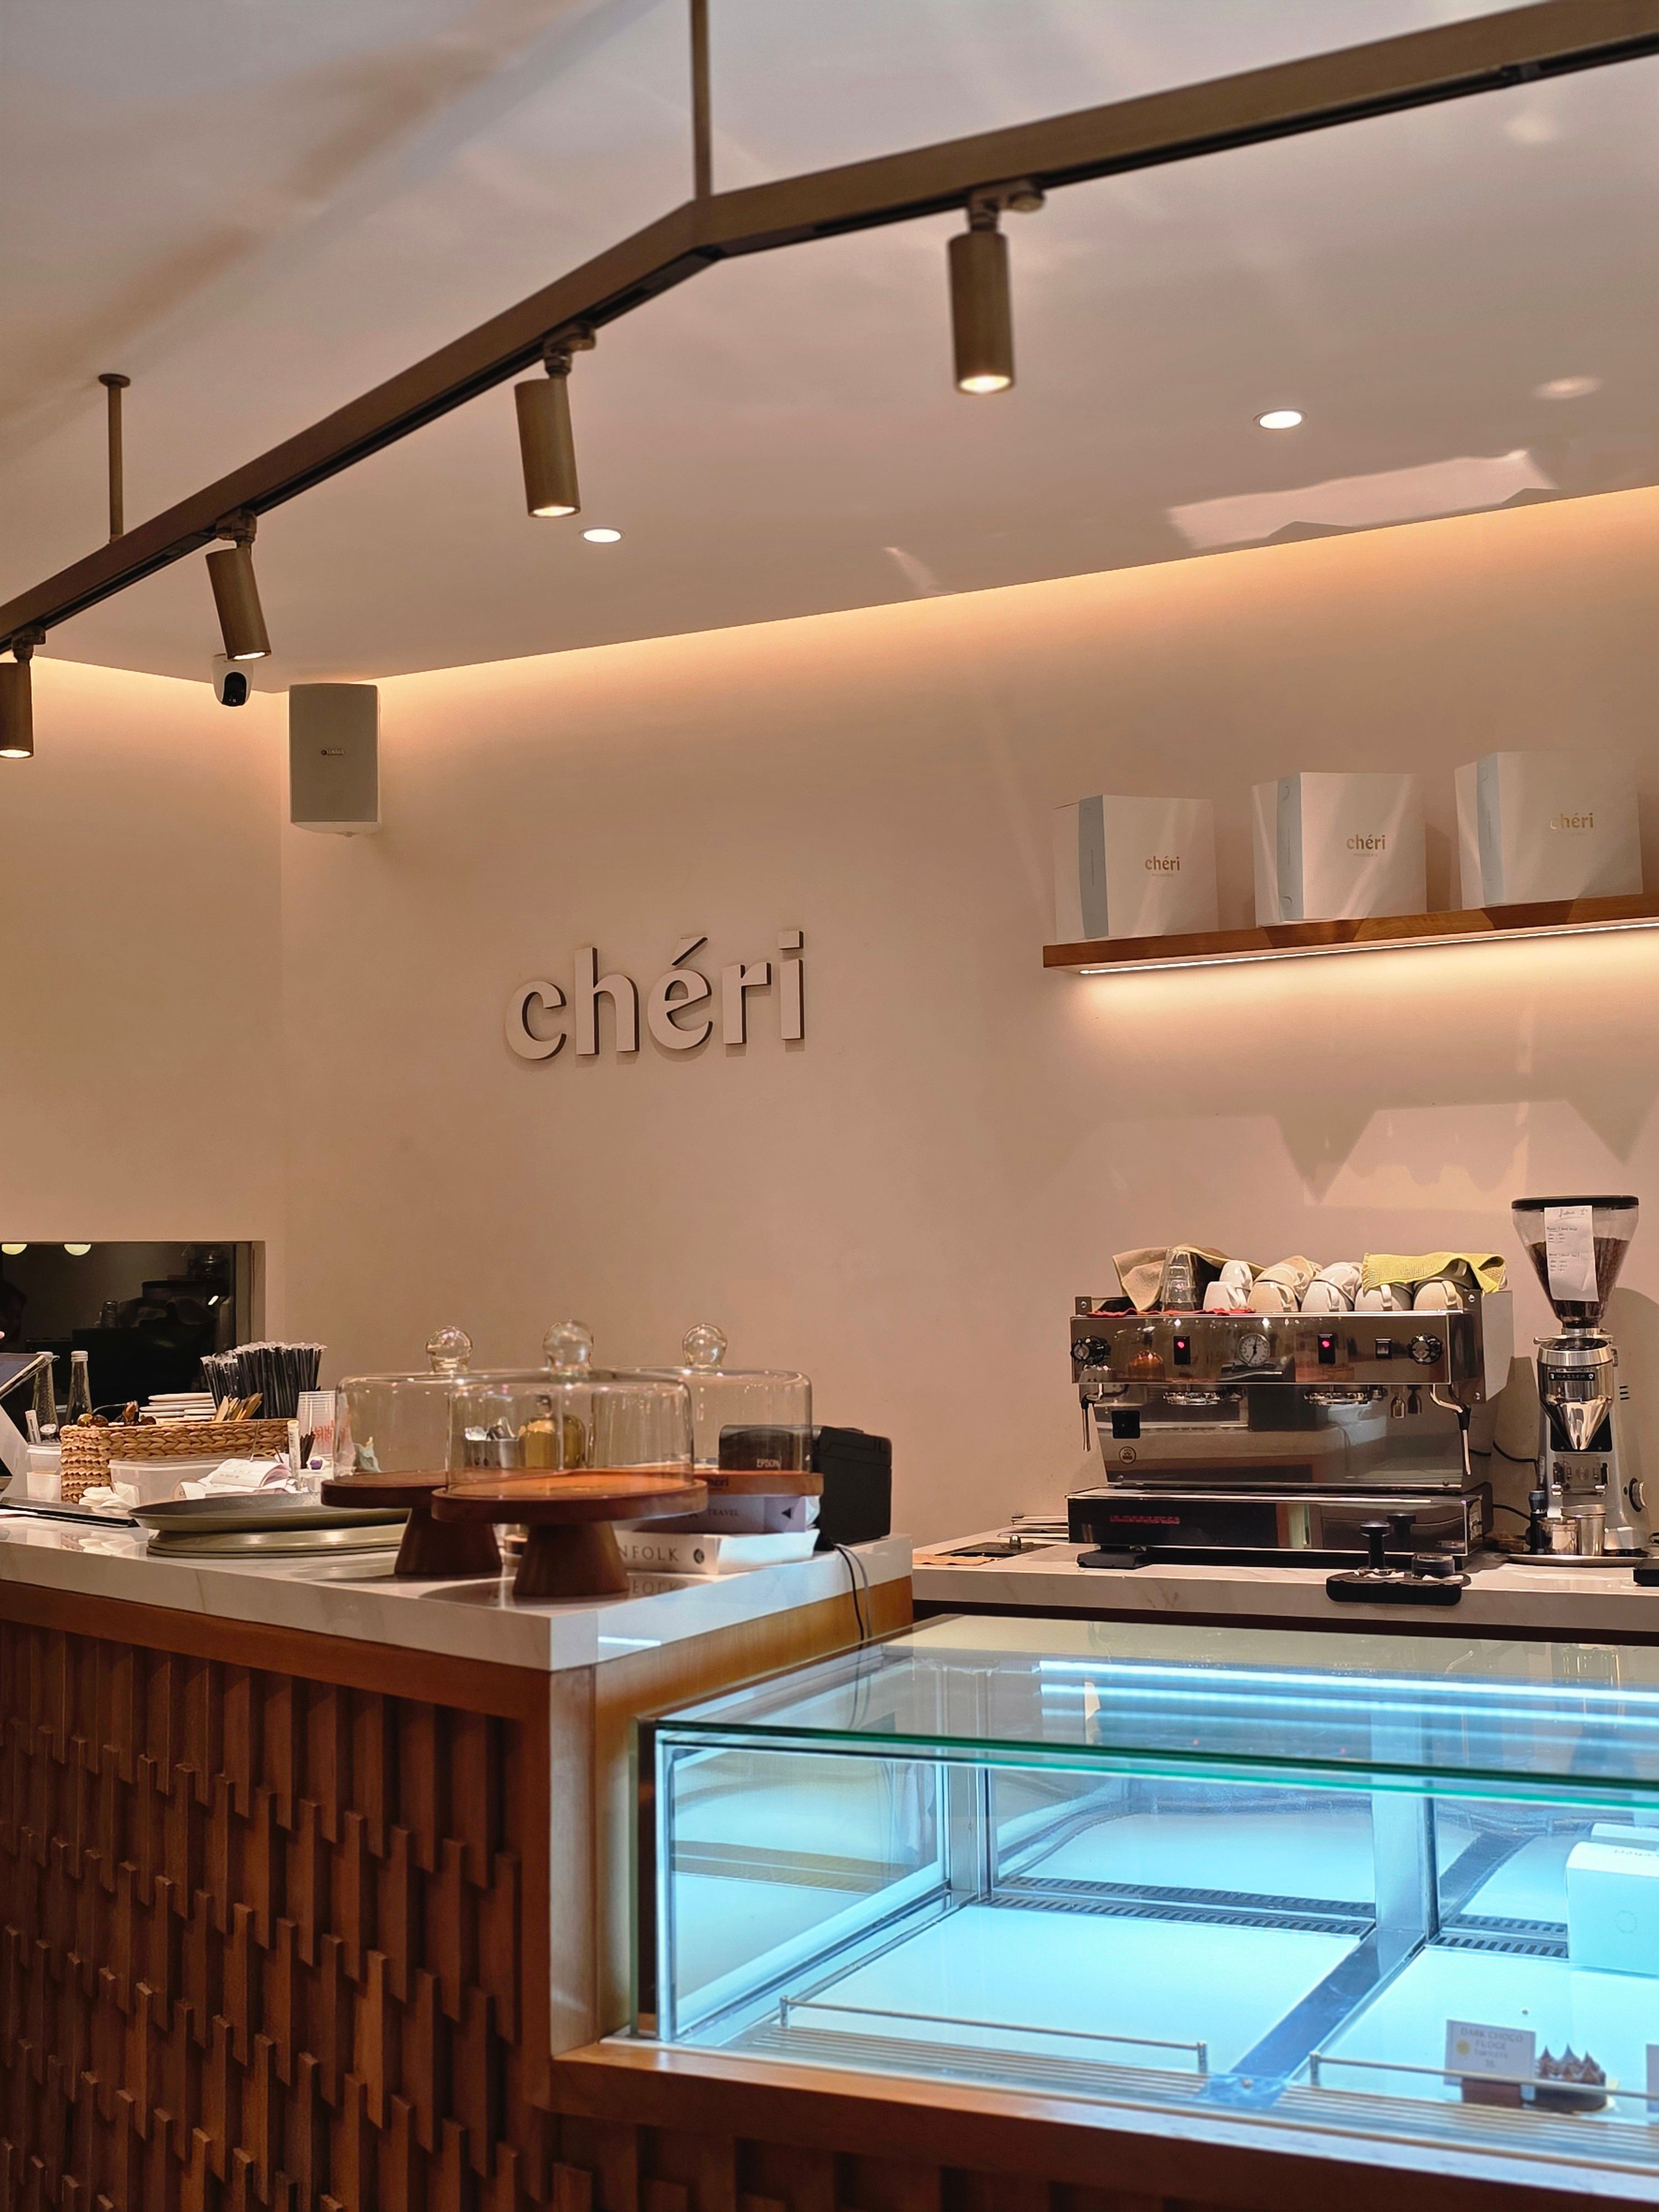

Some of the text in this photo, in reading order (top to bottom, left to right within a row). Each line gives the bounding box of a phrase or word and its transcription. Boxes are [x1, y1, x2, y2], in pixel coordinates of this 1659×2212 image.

[1346, 834, 1385, 850] chéri
[1145, 855, 1180, 871] chéri
[505, 930, 805, 1060] chéri
[756, 1458, 780, 1468] EPSON
[619, 1545, 679, 1562] NFOLK
